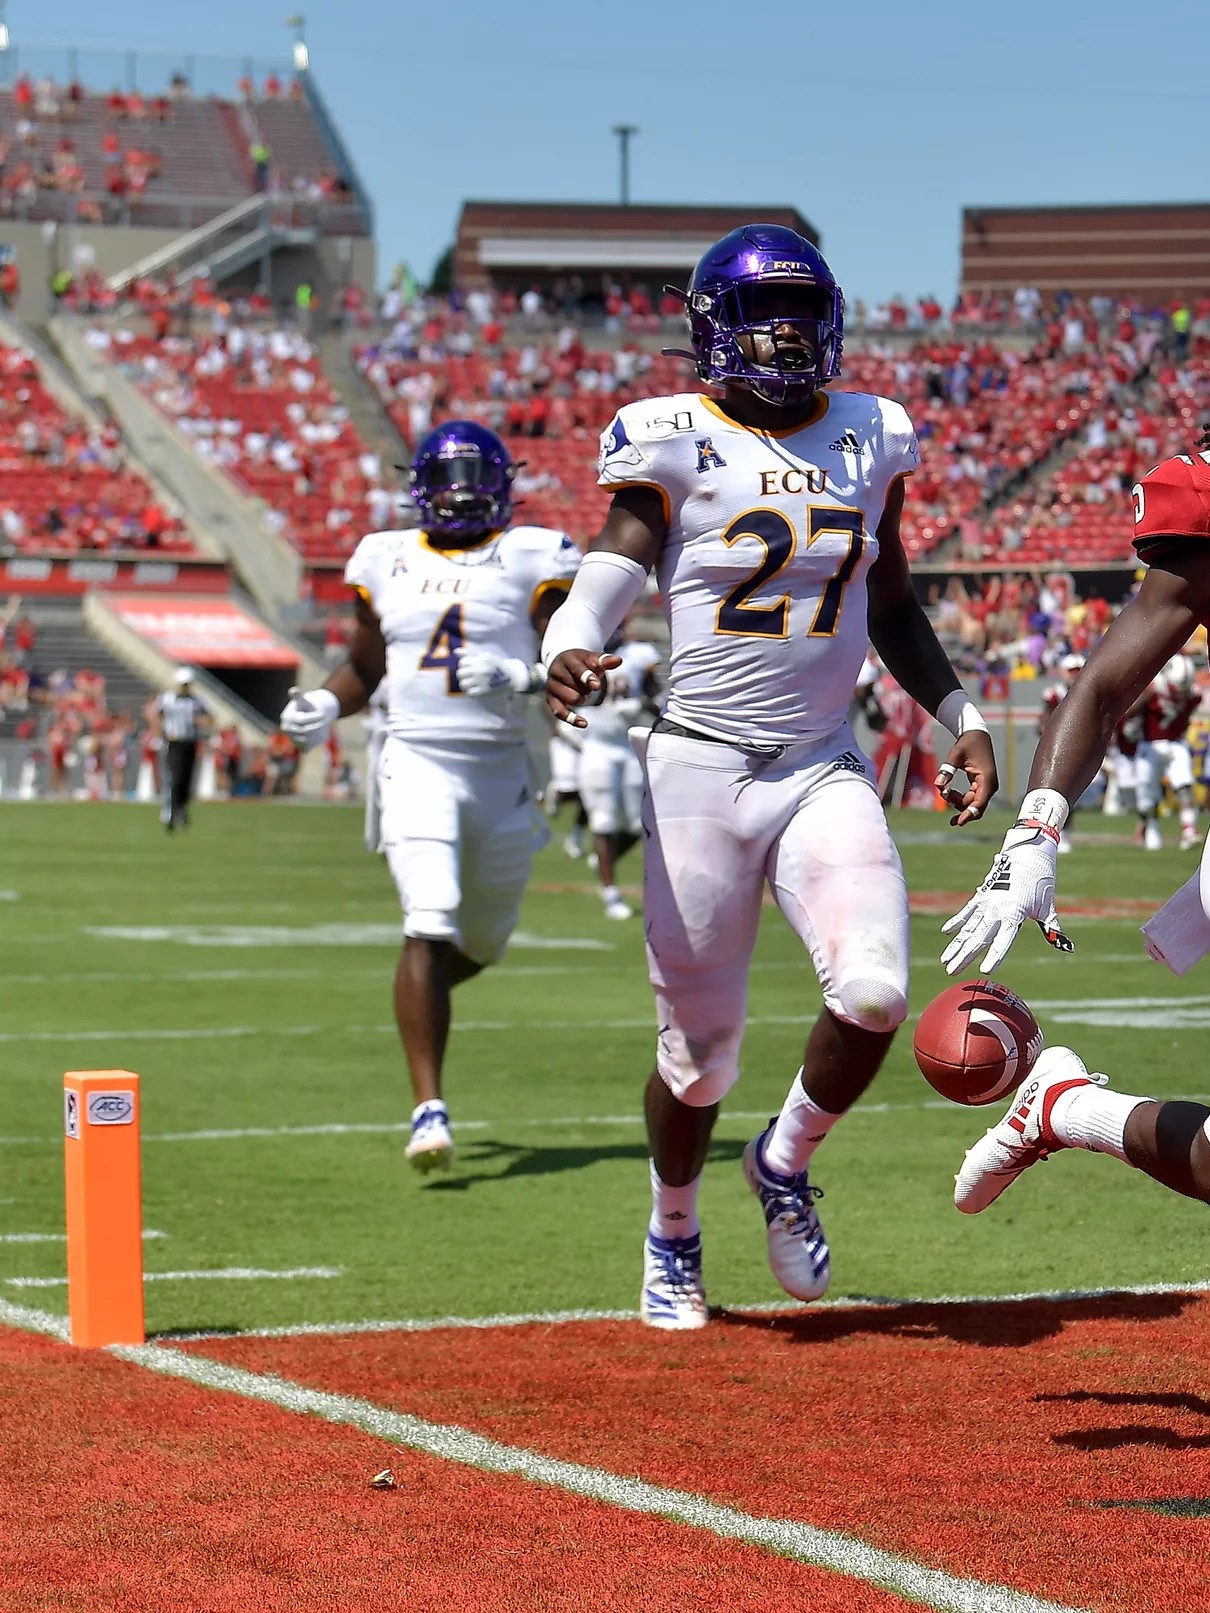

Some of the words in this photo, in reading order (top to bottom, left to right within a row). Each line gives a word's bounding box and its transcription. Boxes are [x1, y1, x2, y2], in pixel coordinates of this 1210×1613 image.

[828, 443, 865, 456] adidas
[759, 469, 828, 496] ECU
[714, 504, 866, 639] 27
[418, 602, 467, 698] 4
[833, 759, 866, 773] adidas
[981, 854, 1010, 894] adidas
[96, 1101, 125, 1111] ACC
